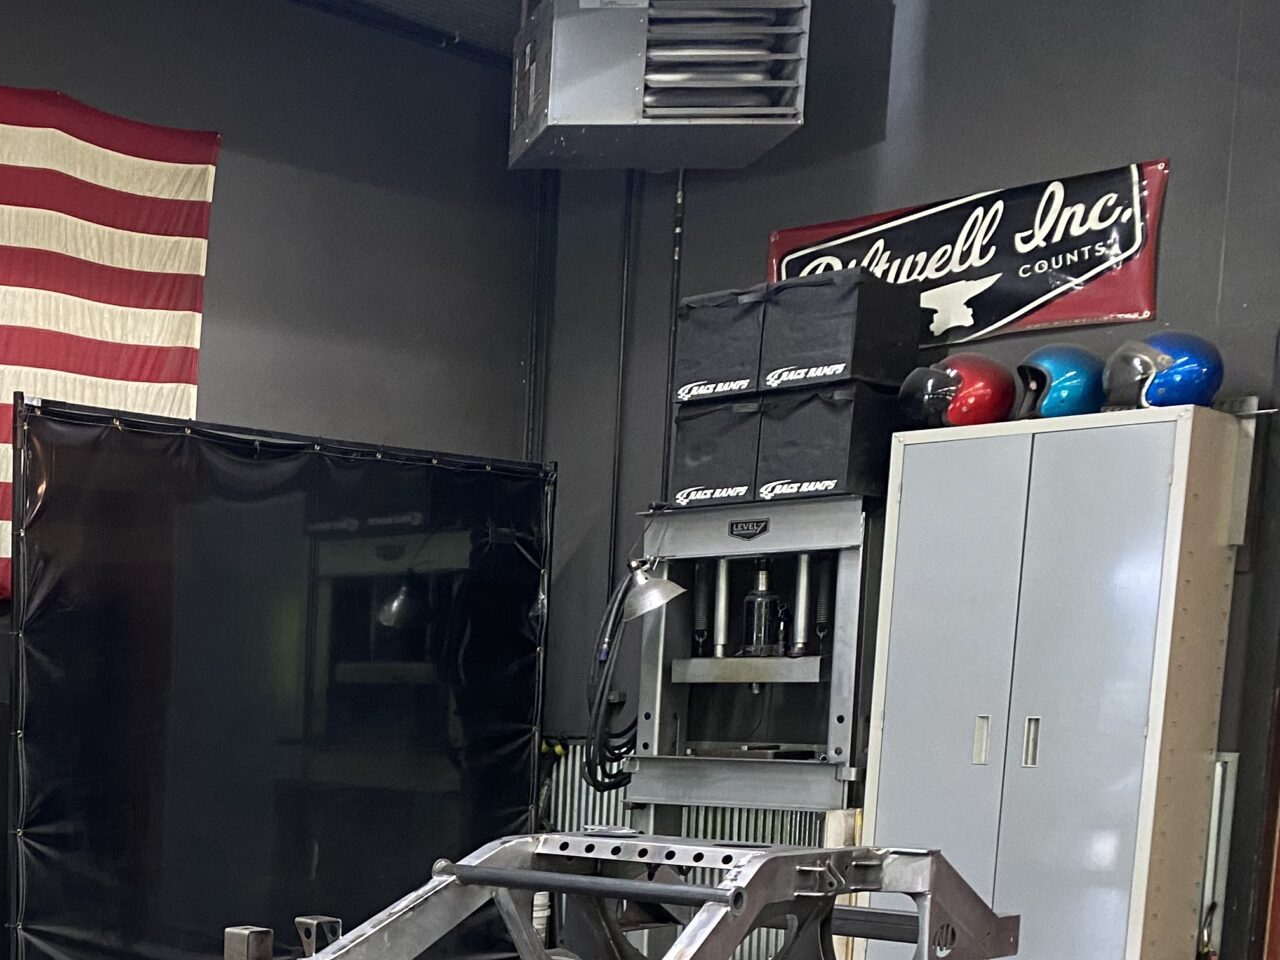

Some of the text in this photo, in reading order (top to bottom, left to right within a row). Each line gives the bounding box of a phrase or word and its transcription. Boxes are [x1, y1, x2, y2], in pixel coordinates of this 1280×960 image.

[1014, 181, 1132, 253] Inc.
[807, 363, 847, 378] RAMPS
[715, 379, 751, 393] RAMPS
[713, 486, 749, 498] RAMPS
[800, 480, 838, 492] RAMPS
